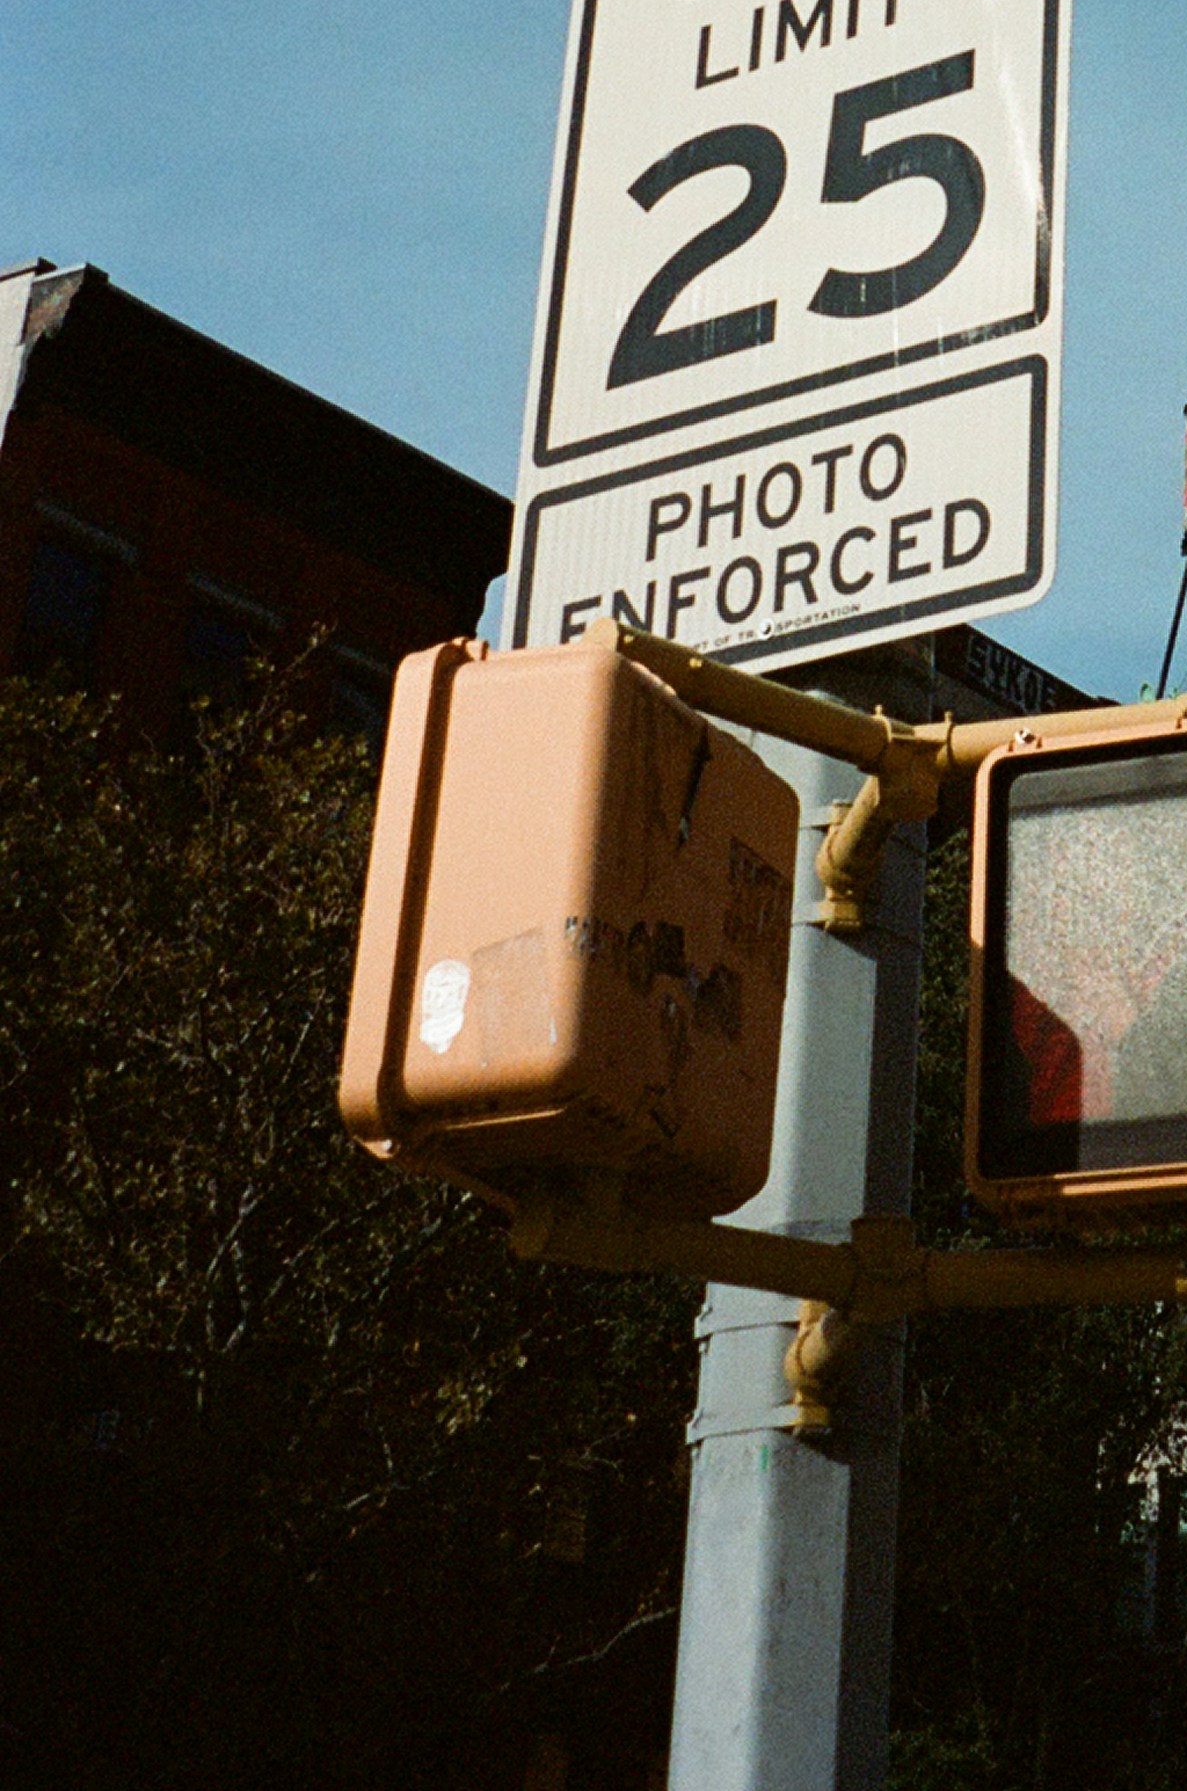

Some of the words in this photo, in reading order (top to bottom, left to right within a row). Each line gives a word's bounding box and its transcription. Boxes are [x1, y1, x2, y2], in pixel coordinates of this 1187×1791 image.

[607, 49, 985, 390] 25
[646, 432, 908, 561] PHOTO
[560, 498, 992, 644] ENFORCED
[738, 604, 861, 639] TRSPORTATION
